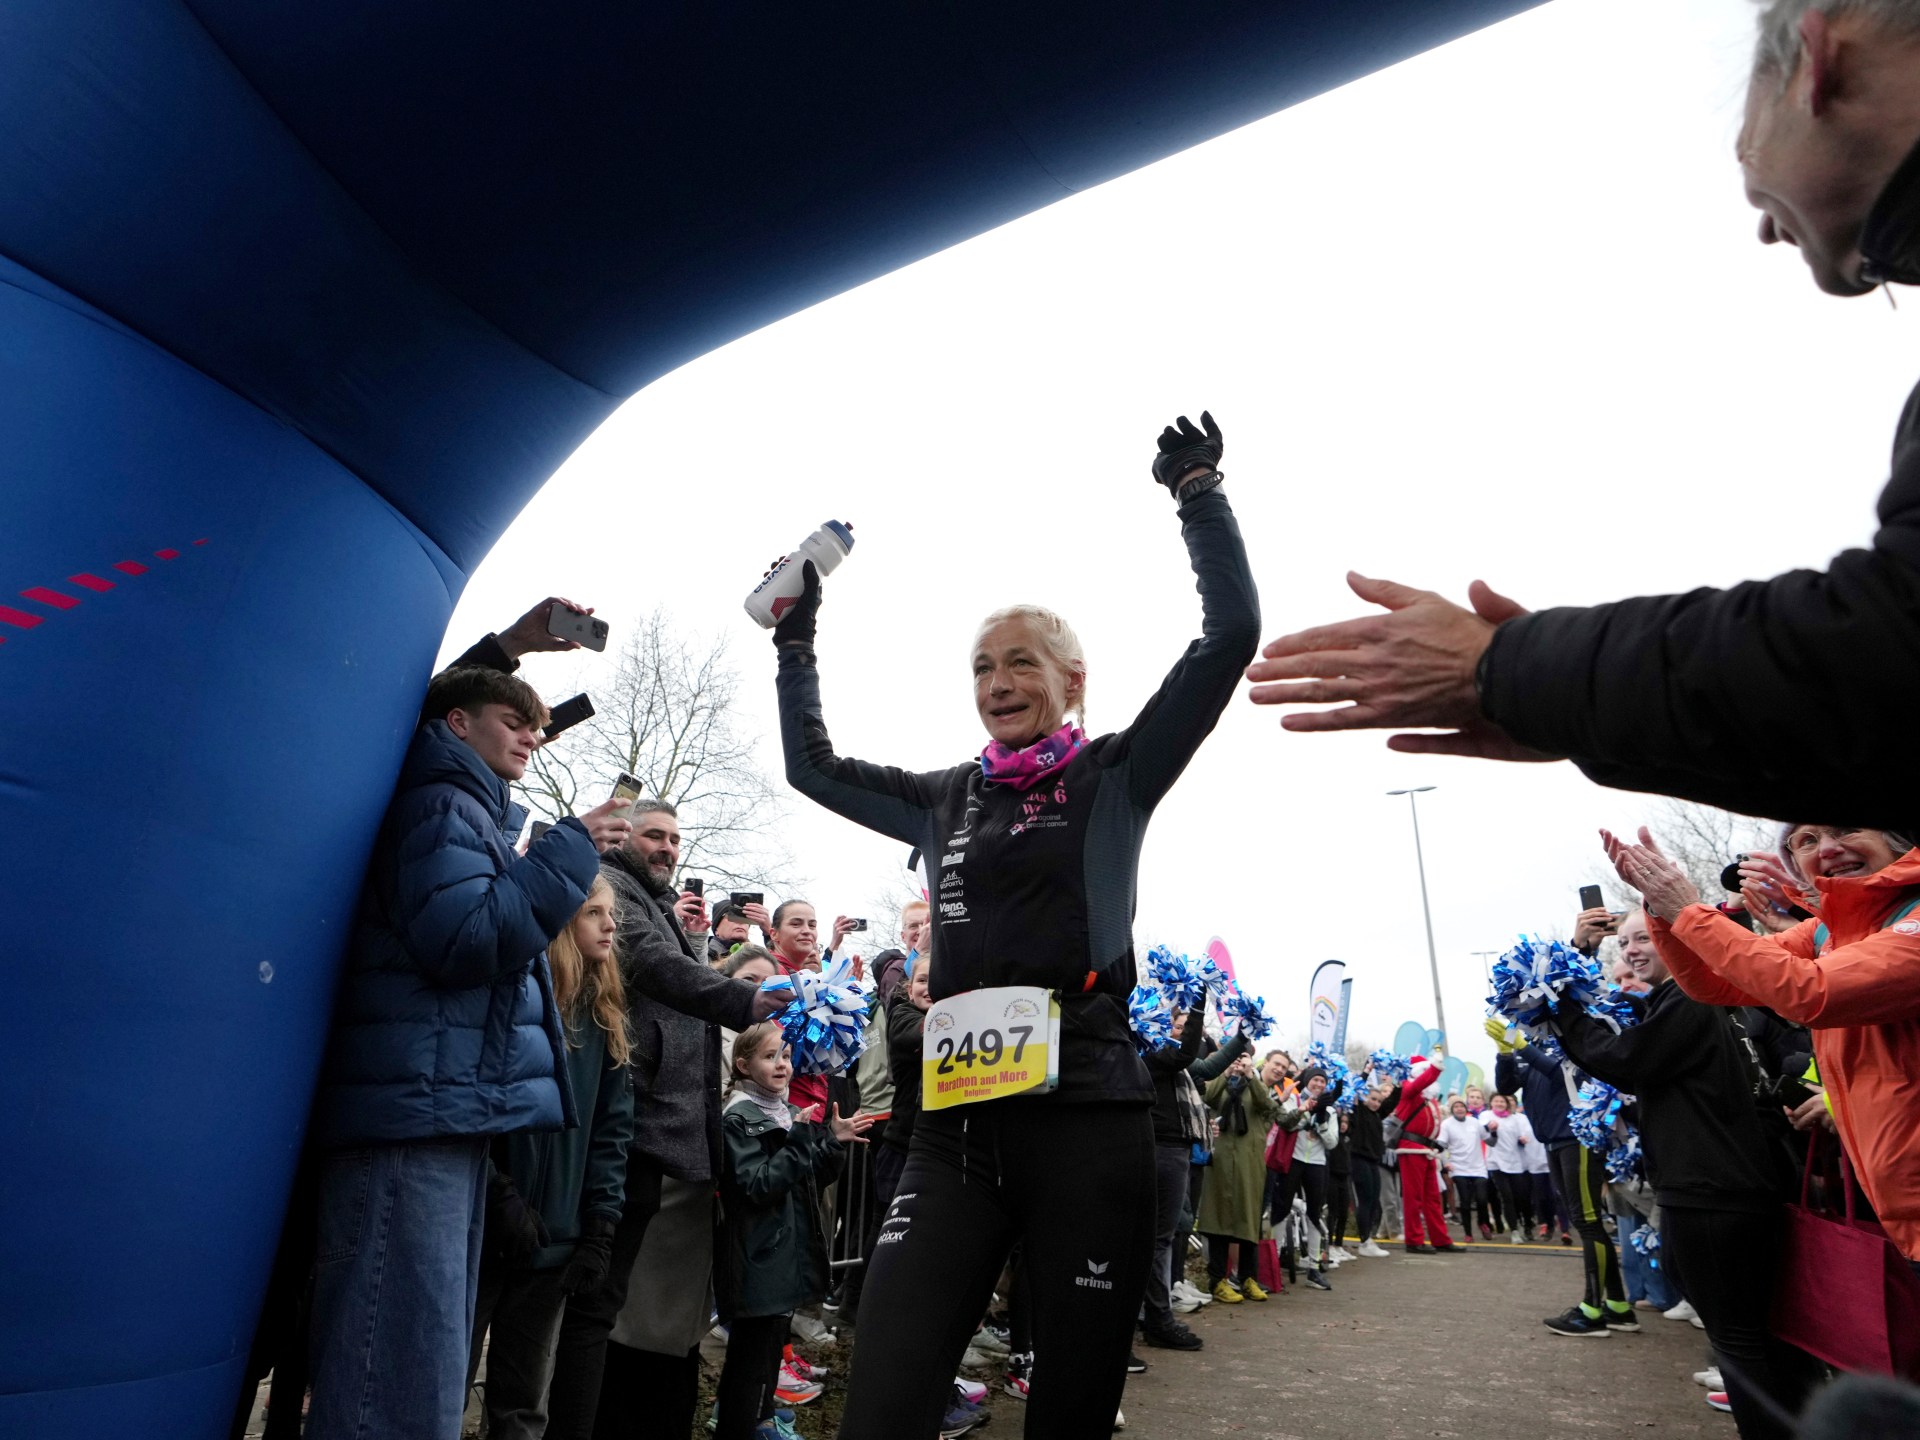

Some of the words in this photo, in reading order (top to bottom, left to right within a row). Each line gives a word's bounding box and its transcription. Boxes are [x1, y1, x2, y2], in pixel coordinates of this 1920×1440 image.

[1054, 788, 1067, 804] 6
[1046, 820, 1068, 828] cancer
[939, 902, 964, 913] Vano
[936, 1025, 1034, 1075] 2497
[937, 1075, 978, 1094] Marathon
[980, 1074, 997, 1086] and
[999, 1070, 1028, 1083] More
[964, 1088, 992, 1098] Belgium
[1075, 1276, 1113, 1290] erima
